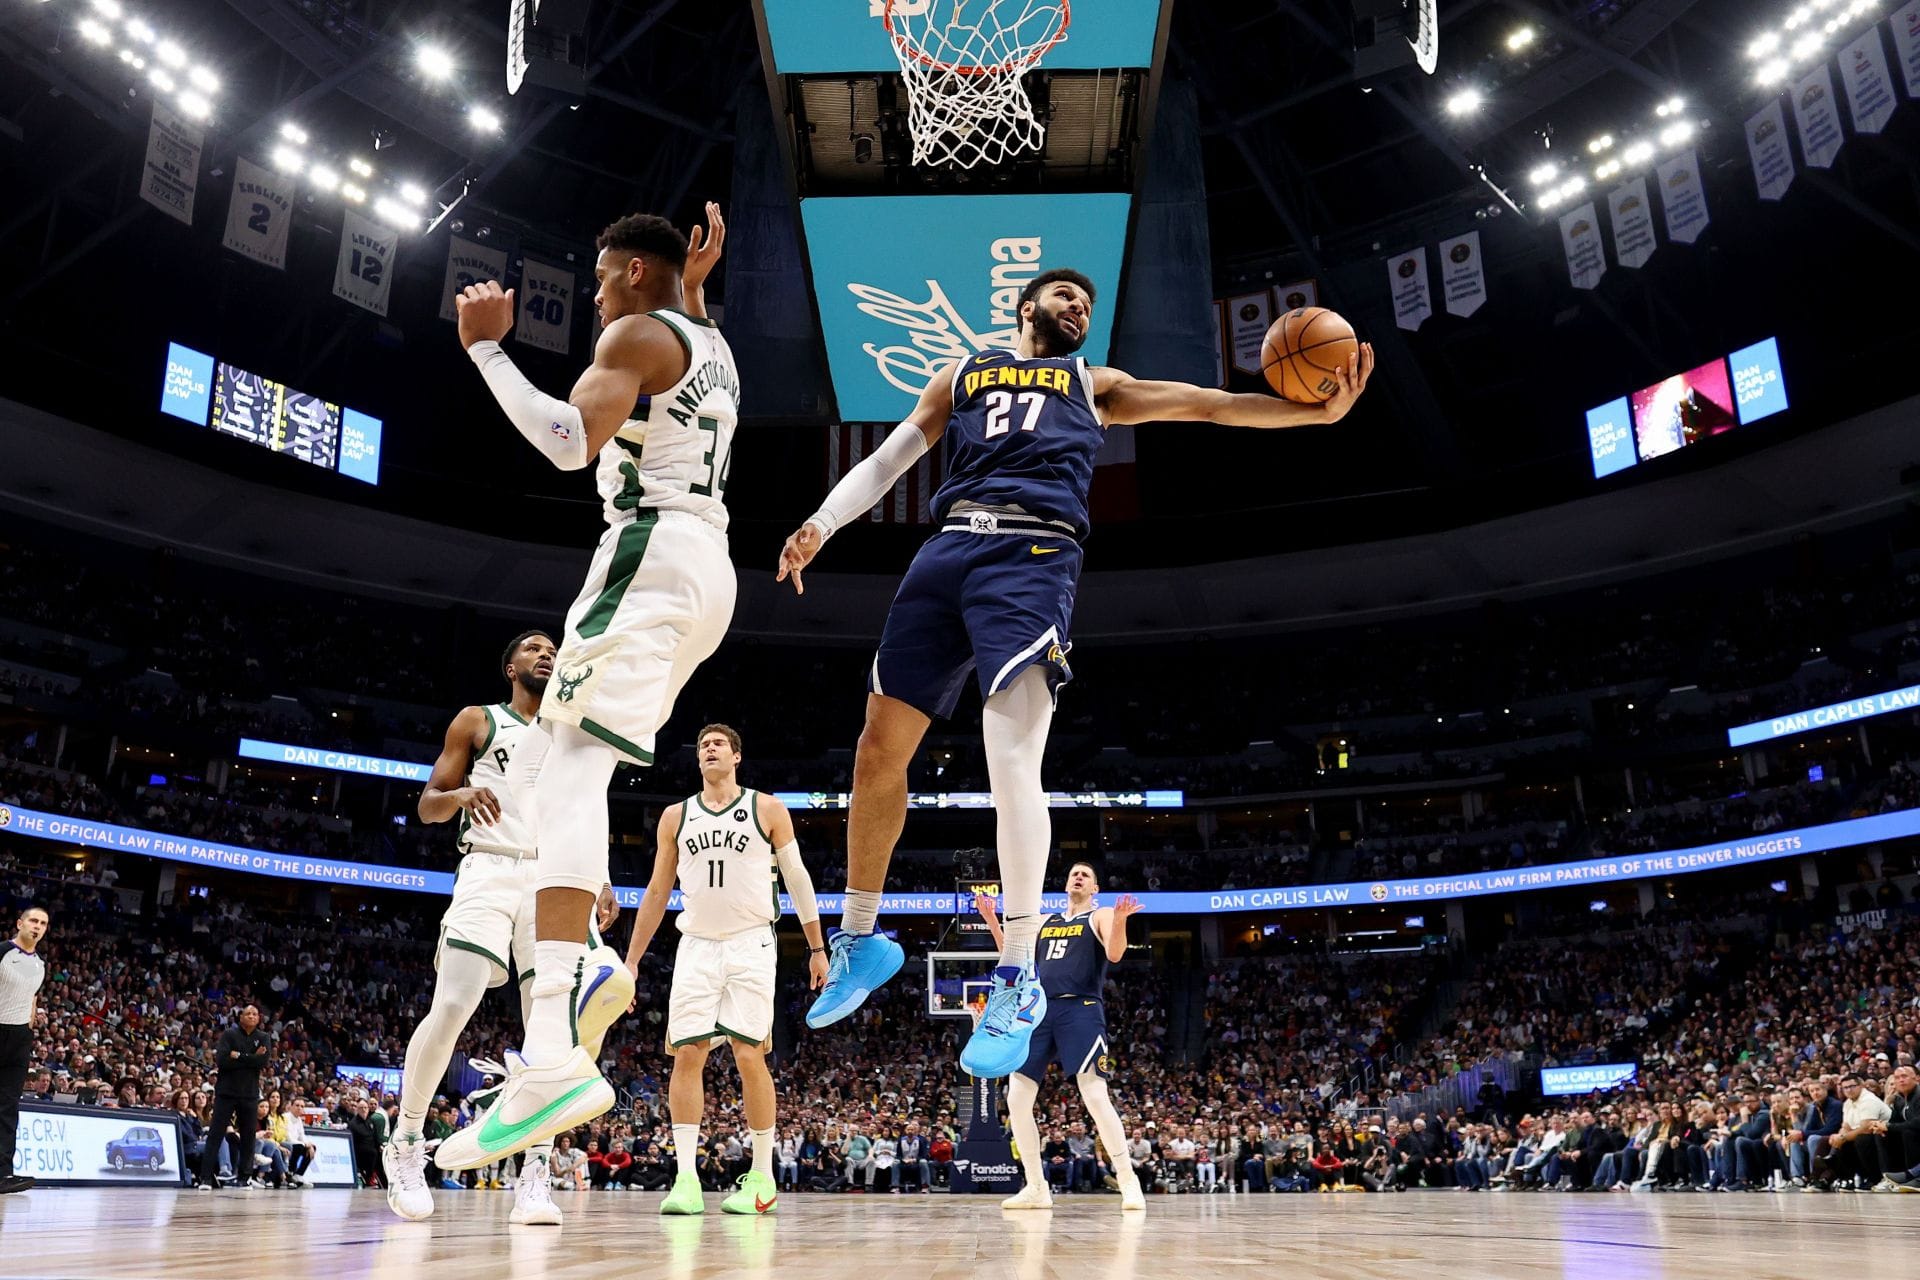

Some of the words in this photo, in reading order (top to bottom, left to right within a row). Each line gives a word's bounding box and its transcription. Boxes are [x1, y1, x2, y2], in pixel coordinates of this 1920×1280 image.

[248, 203, 271, 235] 2
[351, 232, 386, 257] LEVER
[350, 249, 383, 286] 12
[528, 279, 569, 299] BECK
[525, 294, 564, 326] 40
[847, 279, 981, 396] Ball
[168, 361, 193, 378] DAN
[1735, 364, 1761, 382] DAN
[165, 383, 191, 400] LAW
[167, 371, 205, 394] CAPLIS
[964, 366, 1071, 398] DENVER
[1736, 369, 1776, 394] CAPLIS
[1738, 386, 1764, 404] LAW
[985, 390, 1046, 439] 27
[343, 425, 365, 441] DAN
[1591, 422, 1613, 438] DAN
[1592, 427, 1627, 449] CAPLIS
[342, 436, 375, 456] CAPLIS
[342, 447, 364, 461] LAW
[1594, 442, 1616, 459] LAW
[1772, 714, 1808, 735] DAN
[1813, 699, 1875, 724] CAPLIS
[1879, 688, 1920, 711] LAW
[284, 747, 319, 764] DAN
[324, 753, 380, 773] CAPLIS
[385, 762, 420, 778] LAW
[17, 815, 44, 832] THE
[49, 821, 114, 844] OFFICIAL
[119, 833, 150, 849] LAW
[153, 840, 187, 856] FIRM
[191, 846, 249, 867] PARTNER
[252, 856, 270, 869] OF
[273, 859, 299, 874] THE
[304, 863, 359, 880] DENVER
[363, 869, 425, 887] NUGGETS
[685, 829, 750, 856] BUCKS
[708, 860, 724, 888] 11
[1394, 885, 1419, 897] THE
[1424, 879, 1483, 895] OFFICIAL
[1486, 876, 1515, 889] LAW
[1519, 872, 1551, 886] FIRM
[1556, 864, 1618, 881] PARTNER
[1622, 861, 1641, 874] OF
[1644, 857, 1673, 871] THE
[1677, 849, 1733, 868] DENVER
[1736, 836, 1802, 858] NUGGETS
[971, 883, 999, 898] 4:40
[1210, 895, 1245, 909] DAN
[1250, 890, 1307, 906] CAPLIS
[1313, 888, 1349, 903] LAW
[878, 899, 932, 909] PARTNER
[936, 899, 953, 909] OF
[1041, 925, 1084, 939] DENVER
[1045, 939, 1068, 960] 15
[1545, 1072, 1569, 1085] DAN
[1570, 1069, 1606, 1081] CAPLIS
[980, 1077, 989, 1118] outhwest
[32, 1119, 66, 1143] CR-V
[13, 1149, 33, 1171] OF
[38, 1148, 74, 1172] SUVS
[971, 1163, 1019, 1174] Fanatics
